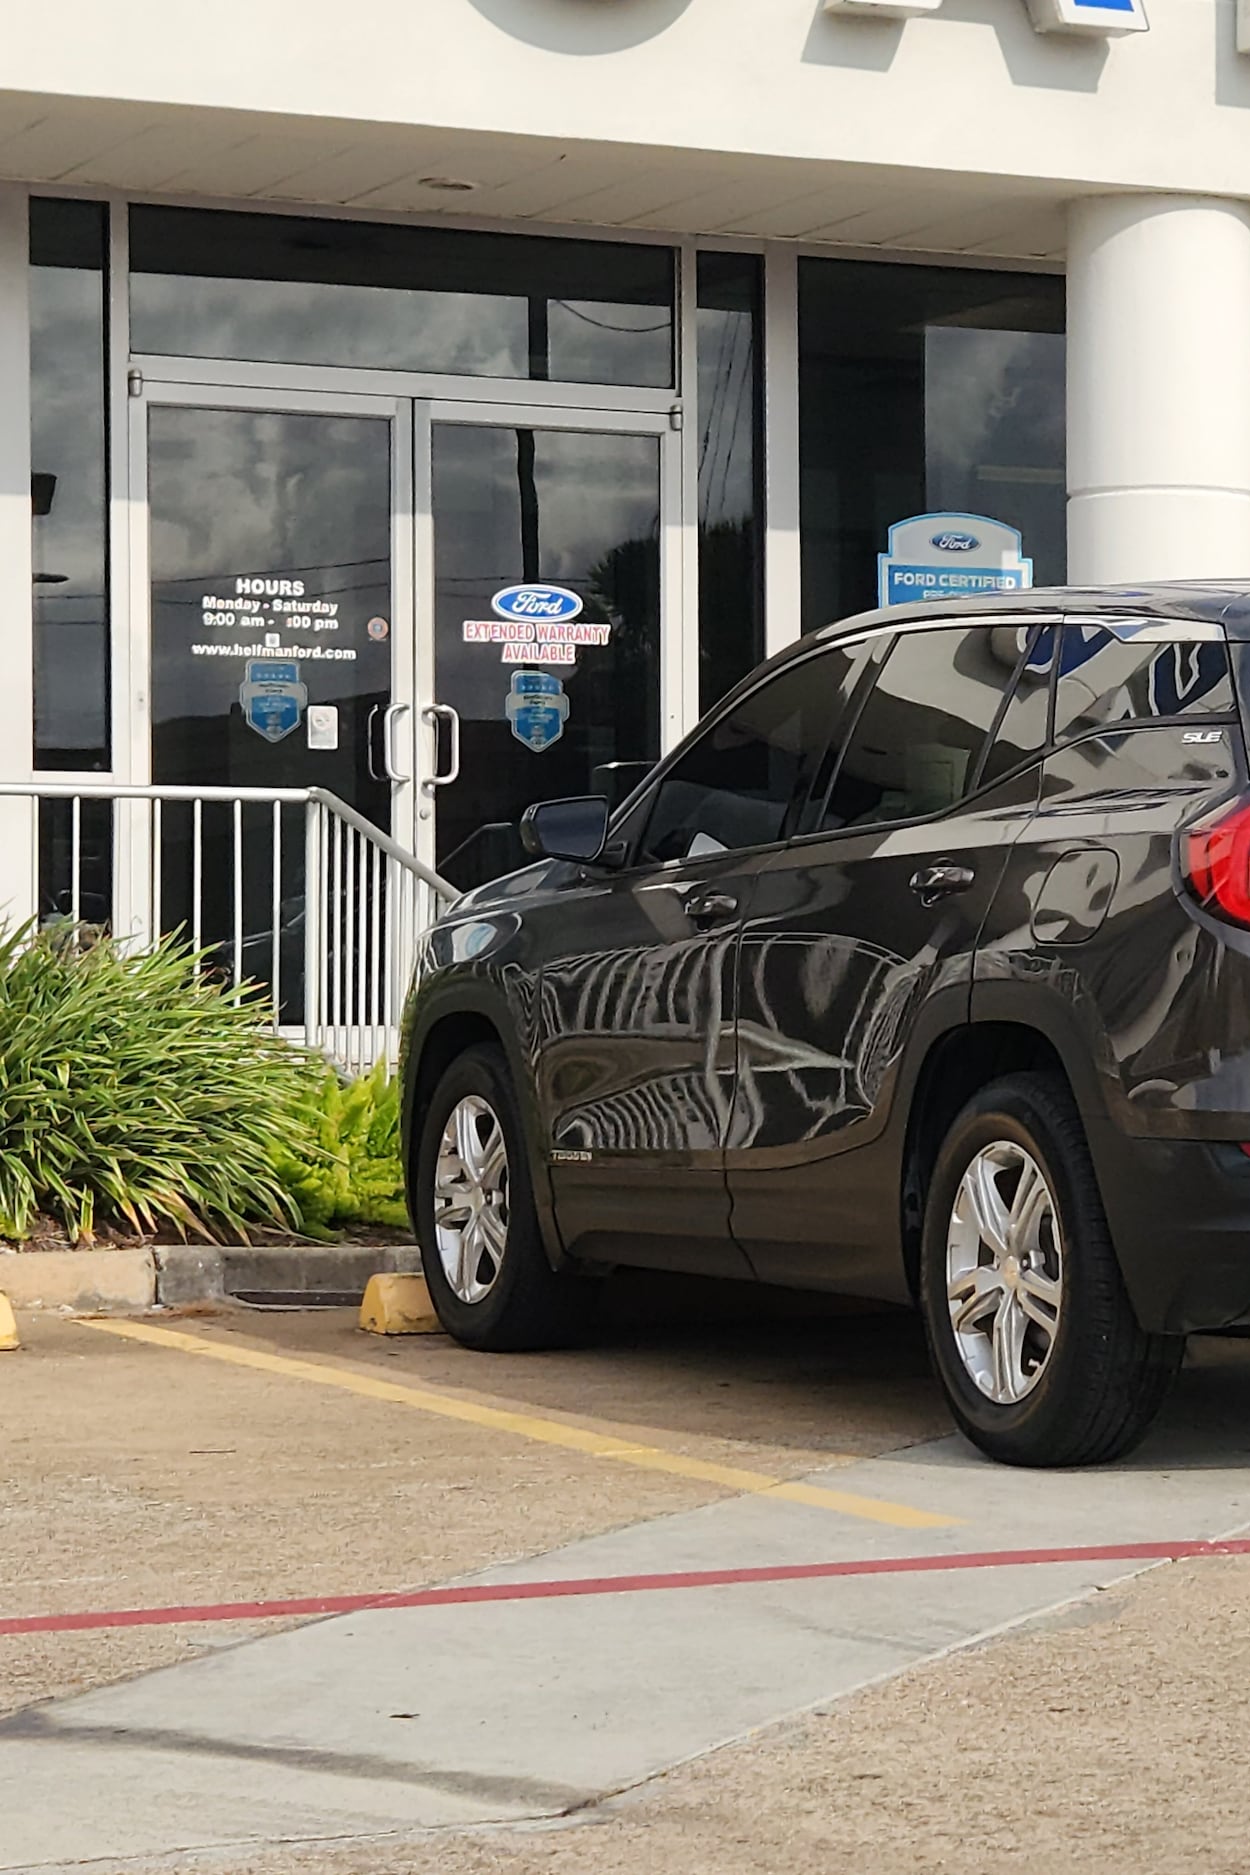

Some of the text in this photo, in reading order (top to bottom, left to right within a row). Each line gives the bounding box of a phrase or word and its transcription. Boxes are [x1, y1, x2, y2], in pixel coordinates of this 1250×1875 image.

[236, 578, 305, 596] HOURS
[893, 572, 1016, 589] FORD CERTIFIED
[202, 596, 260, 613] Monday
[273, 599, 338, 616] Saturday
[512, 592, 563, 613] Ford
[240, 617, 265, 627] am
[314, 619, 339, 631] pm
[466, 622, 609, 642] EXTENDED WARRANTY
[191, 643, 357, 660] www.helfmanford.com
[504, 644, 574, 661] AVAILABLE
[1182, 730, 1222, 744] SLE
